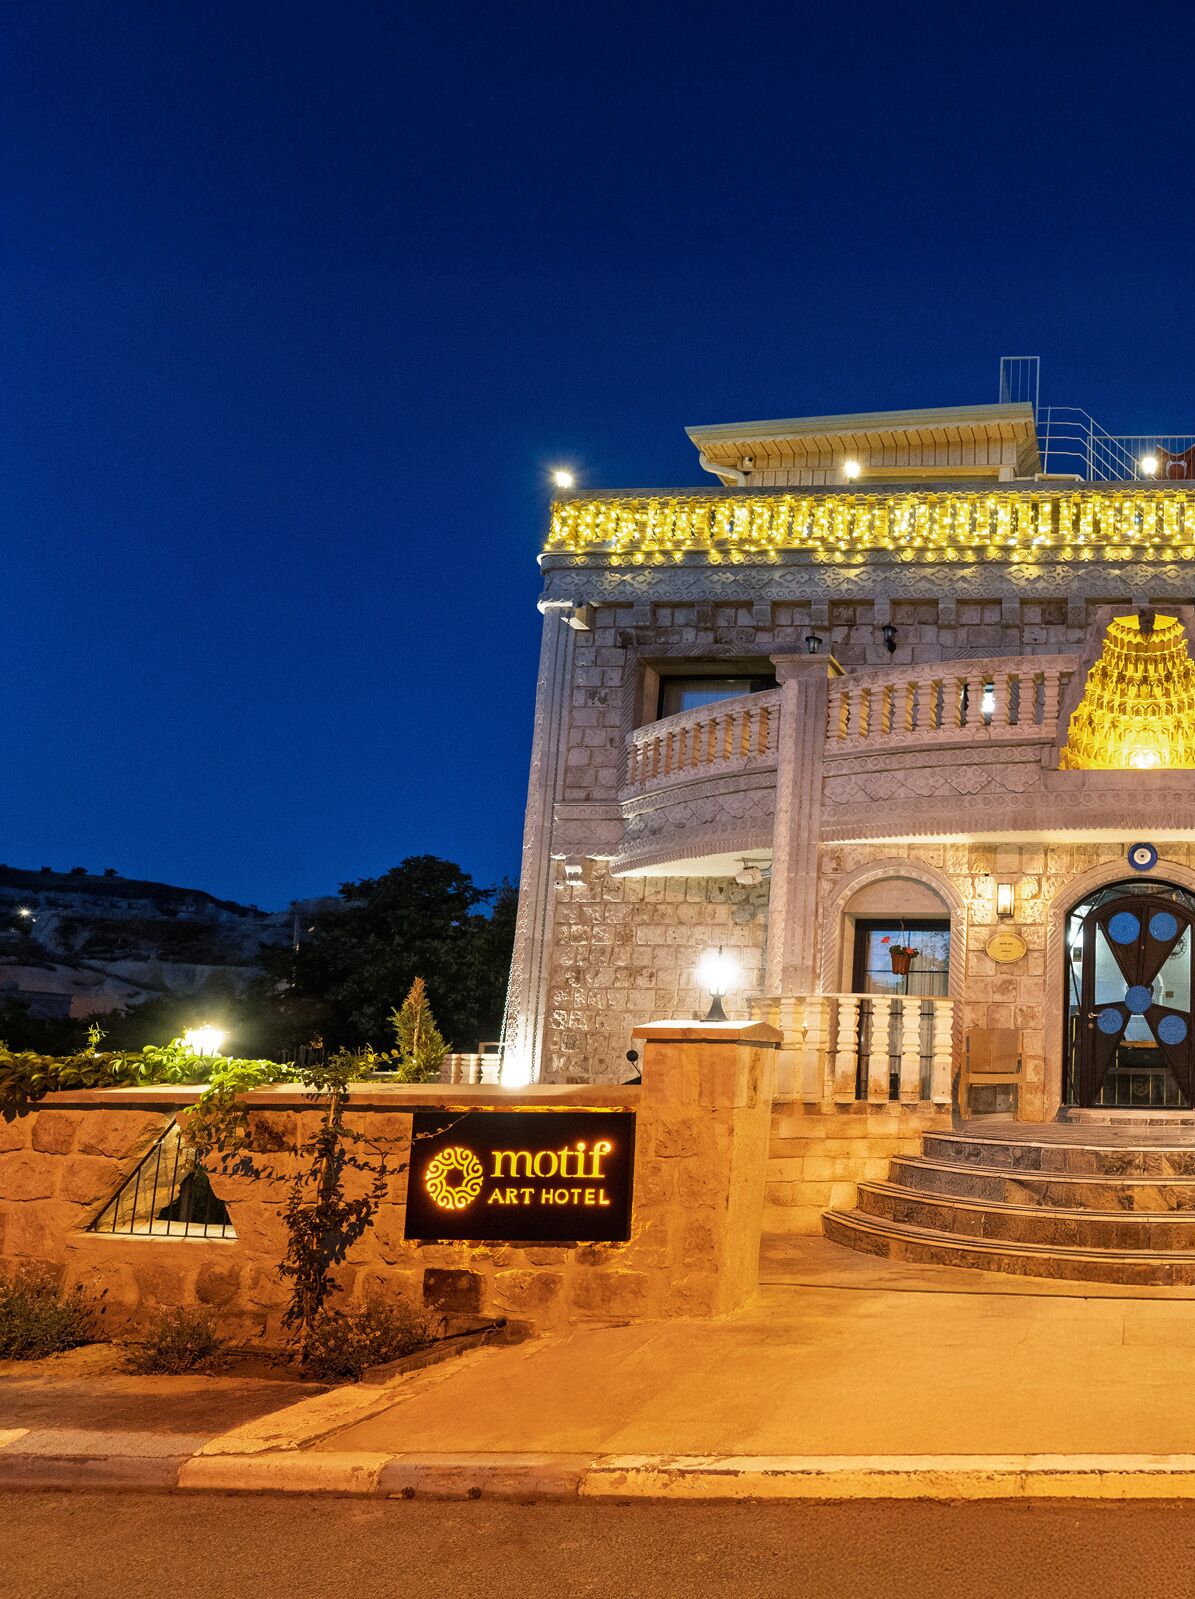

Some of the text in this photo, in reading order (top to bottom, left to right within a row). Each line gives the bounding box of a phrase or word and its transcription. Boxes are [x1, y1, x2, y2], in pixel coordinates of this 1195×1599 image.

[490, 1141, 612, 1178] motif
[488, 1188, 610, 1205] ART HOTEL
